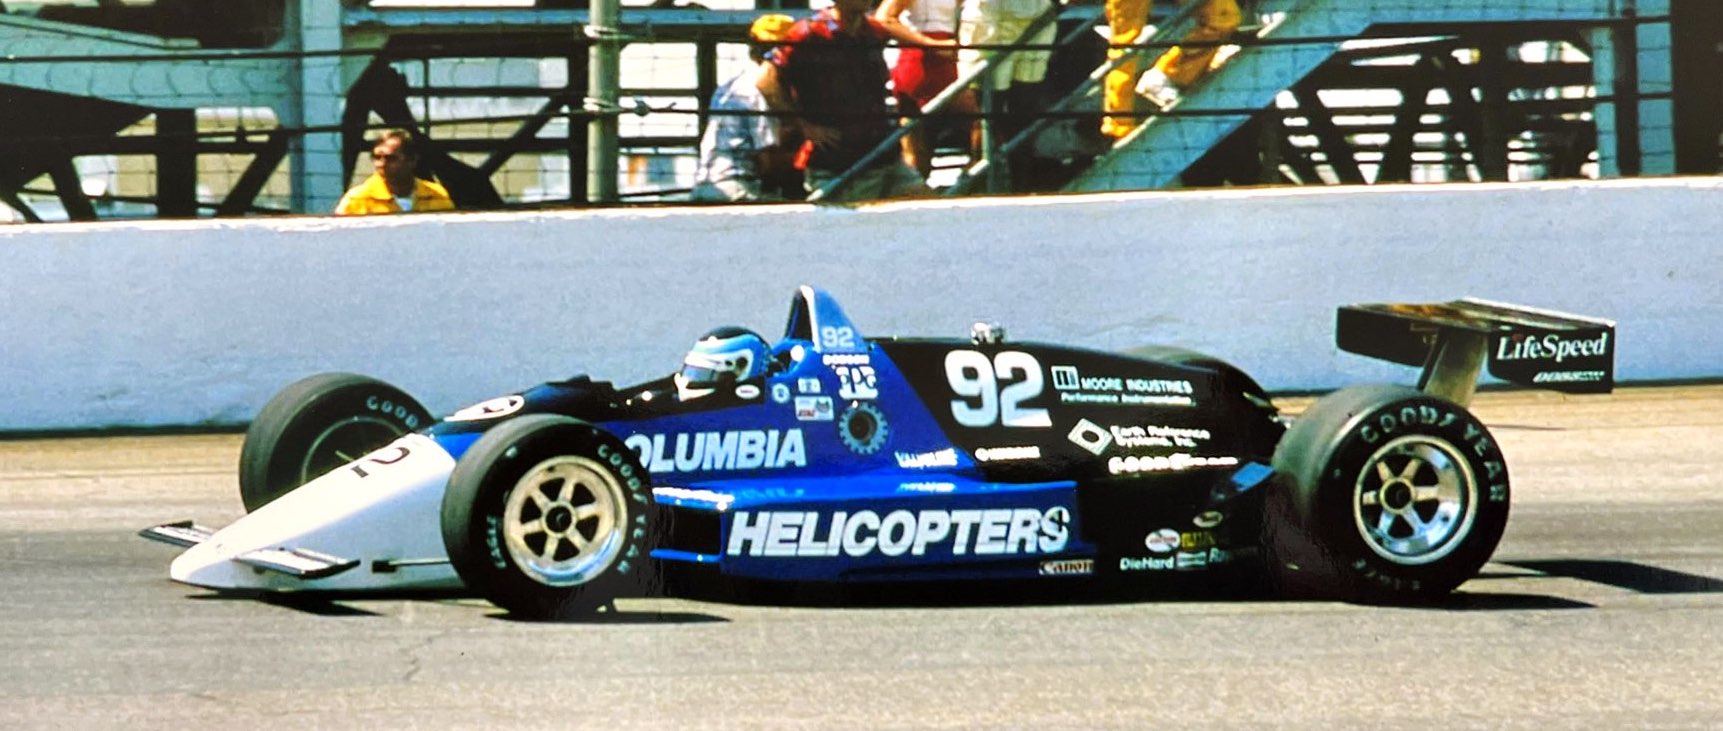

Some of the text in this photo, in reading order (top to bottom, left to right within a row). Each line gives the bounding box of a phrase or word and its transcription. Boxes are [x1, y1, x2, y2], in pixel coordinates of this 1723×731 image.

[821, 325, 855, 348] 92
[1496, 332, 1607, 362] LifeSpeed
[944, 350, 1053, 427] 92
[1081, 377, 1193, 394] MOORE INDUSTRIES
[624, 428, 807, 473] OLUMBIA
[727, 506, 1070, 556] HELICOPTERS
[1119, 556, 1175, 571] DieHard
